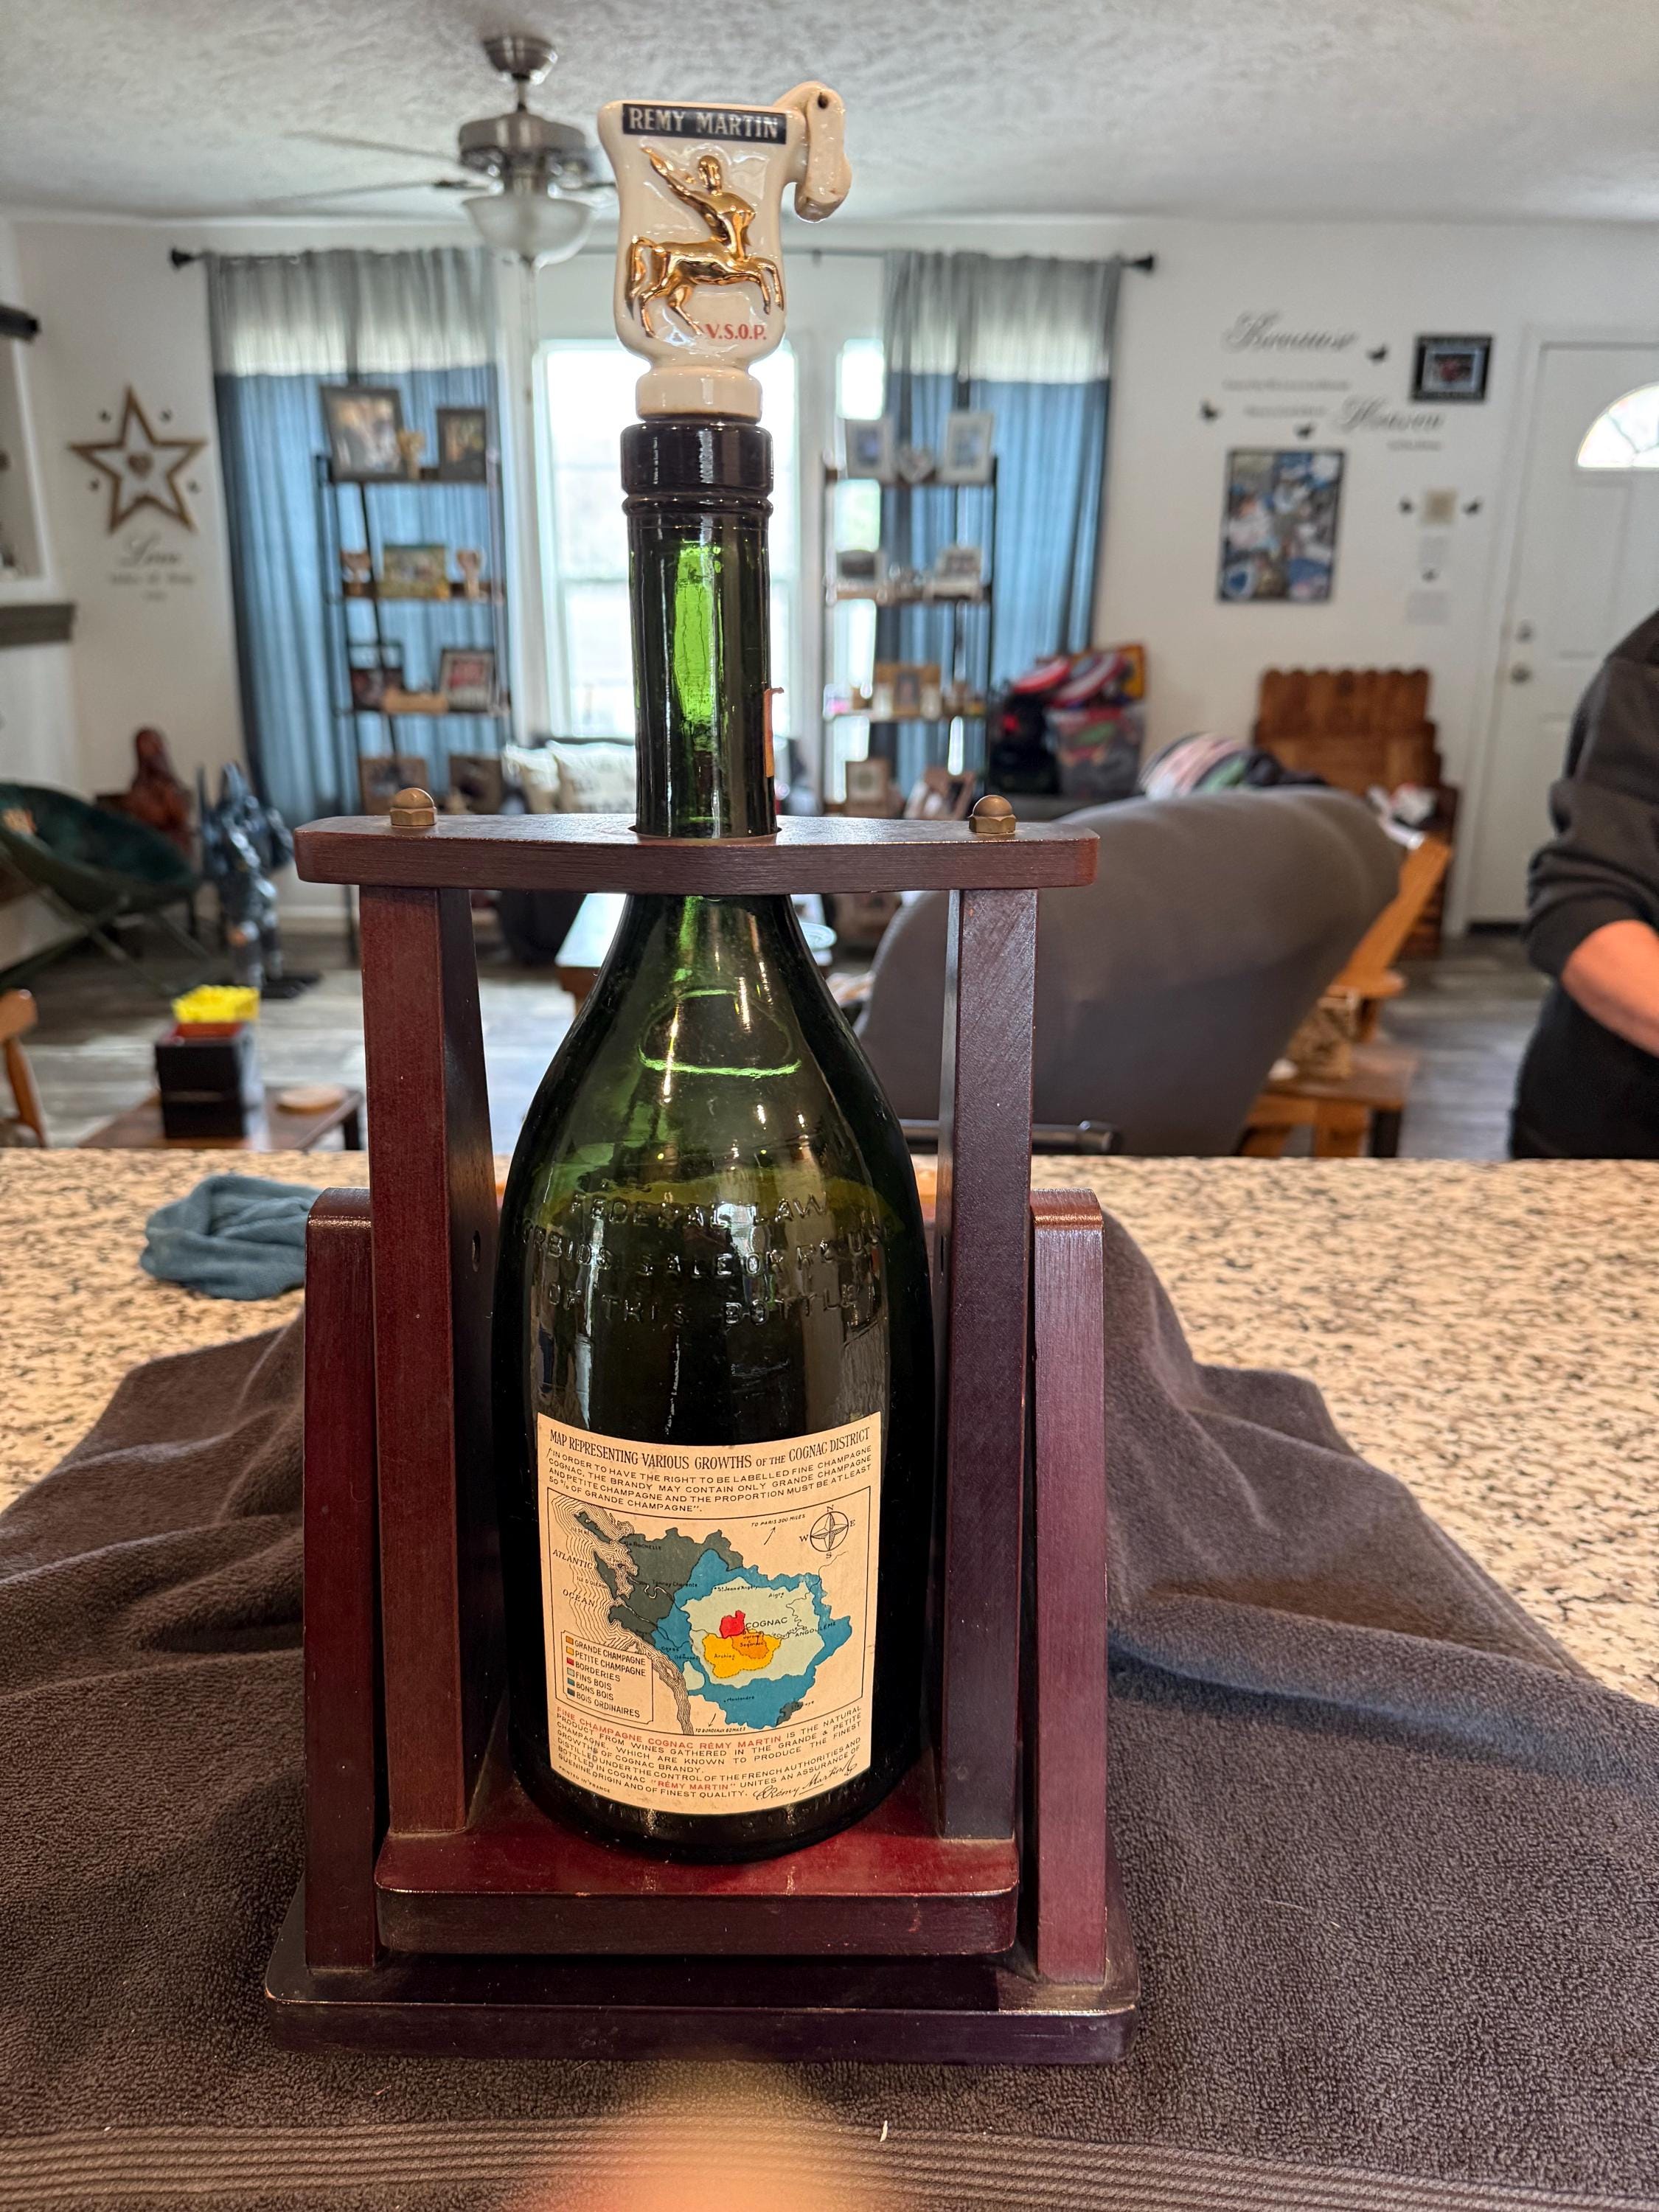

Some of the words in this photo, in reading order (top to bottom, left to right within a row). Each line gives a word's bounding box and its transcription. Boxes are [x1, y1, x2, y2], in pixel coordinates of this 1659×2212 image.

[629, 107, 685, 132] REMY
[695, 111, 779, 139] MARTIN
[706, 324, 767, 340] V.S.O.P.
[636, 1253, 733, 1279] SALE
[602, 1294, 687, 1325] THIS
[725, 1284, 857, 1325] BOTTLE
[550, 1429, 567, 1447] MAP
[569, 1436, 639, 1464] REPRESENTING
[641, 1453, 689, 1470] VARIOUS
[695, 1455, 752, 1470] GROWTHS
[756, 1458, 768, 1467] OF
[769, 1455, 786, 1465] THE
[789, 1441, 828, 1462] COGNAC
[830, 1427, 870, 1453] DISTRICT
[562, 1454, 592, 1469] ORDER
[594, 1464, 607, 1473] TO
[609, 1468, 637, 1479] HAVE
[639, 1473, 661, 1482] THE
[664, 1475, 696, 1484] RIGHT
[733, 1470, 789, 1483] LABELLED
[792, 1464, 814, 1475] FINE
[817, 1445, 872, 1469] CHAMPAGNE
[588, 1472, 606, 1482] THE
[611, 1478, 653, 1491] BRANDY
[659, 1485, 681, 1493] MAY
[686, 1486, 734, 1494] CONTAIN
[737, 1483, 767, 1492] ONLY
[772, 1474, 814, 1488] GRANDE
[817, 1455, 872, 1478] CHAMPAGNE
[549, 1467, 566, 1479] AND
[566, 1475, 599, 1489] PETITE
[600, 1485, 662, 1501] CHAMPAGNE
[714, 1489, 785, 1503] PROPORTION
[787, 1483, 814, 1495] MUST
[816, 1479, 829, 1488] BE
[830, 1475, 844, 1484] AT
[844, 1464, 872, 1480] LEAST
[571, 1485, 582, 1493] OF
[585, 1490, 624, 1505] GRANDE
[827, 1504, 835, 1512] N
[849, 1519, 856, 1527] E
[799, 1534, 810, 1543] W
[553, 1548, 593, 1570] ATLANTIC
[563, 1590, 596, 1607] OCEAN
[745, 1617, 788, 1629] COGNAC
[575, 1640, 602, 1655] GRANDE
[603, 1649, 646, 1666] CHAMPAGNE
[575, 1650, 599, 1666] PETITE
[600, 1659, 646, 1677] CHAMPAGNE
[575, 1660, 621, 1683] BORDERIES
[575, 1671, 591, 1684] FINS
[594, 1678, 612, 1691] BOIS
[576, 1682, 594, 1694] BONS
[596, 1689, 613, 1701] BOIS
[577, 1691, 591, 1704] BOIS
[594, 1699, 640, 1718] ORDINAIRES
[557, 1706, 576, 1721] FINE
[580, 1718, 642, 1743] CHAMPAGNE
[648, 1738, 694, 1749] COGNAC
[737, 1735, 782, 1748] MARTIN
[801, 1724, 819, 1735] THE
[823, 1705, 862, 1727] NATURAL
[557, 1712, 594, 1736] PRODUCT
[599, 1734, 625, 1746] FROM
[631, 1742, 664, 1753] WINES
[752, 1745, 771, 1753] THE
[778, 1733, 818, 1749] GRANDE
[833, 1712, 861, 1732] PETITE
[557, 1730, 599, 1754] GROWTHS
[615, 1755, 655, 1768] COGNAC
[616, 1746, 650, 1759] WHICH
[658, 1755, 678, 1764] ARE
[754, 1746, 801, 1762] PRODUCE
[810, 1737, 827, 1749] THE
[833, 1721, 861, 1739] FINEST
[557, 1737, 598, 1762] DISTILLED
[599, 1756, 631, 1771] UNDER
[633, 1767, 652, 1776] THE
[653, 1771, 702, 1781] CONTROL
[742, 1768, 782, 1780] FRENCH
[785, 1746, 844, 1772] AUTHORITIES
[845, 1736, 861, 1749] AND
[558, 1745, 594, 1768] BOTTLED
[596, 1764, 605, 1773] IN
[608, 1768, 646, 1783] COGNAC
[740, 1777, 777, 1787] UNITES
[780, 1773, 793, 1781] AN
[796, 1751, 849, 1777] ASSURANCE
[851, 1745, 860, 1754] OF
[593, 1771, 622, 1786] ORIGIN
[624, 1781, 643, 1790] AND
[661, 1789, 696, 1798] FINEST
[699, 1790, 748, 1799] QUALITY.
